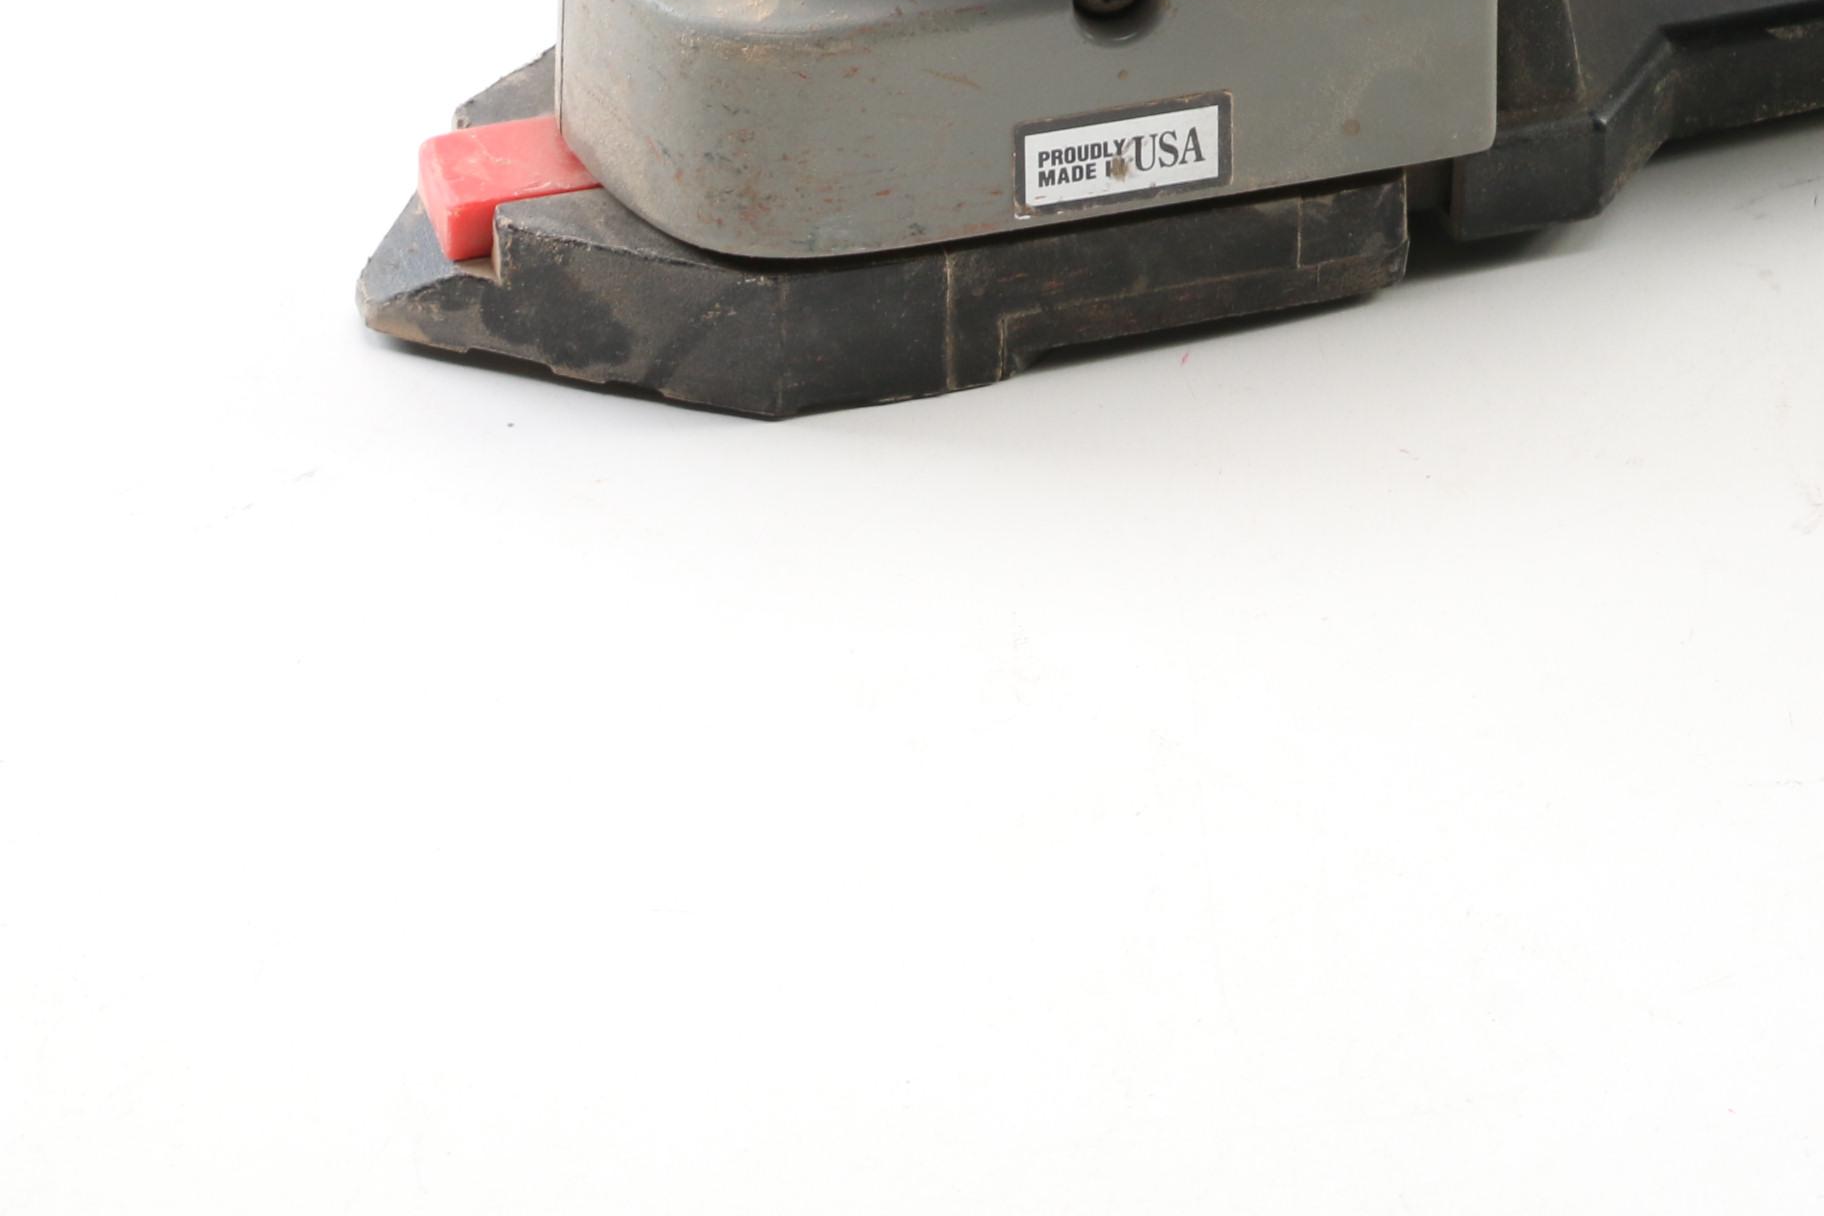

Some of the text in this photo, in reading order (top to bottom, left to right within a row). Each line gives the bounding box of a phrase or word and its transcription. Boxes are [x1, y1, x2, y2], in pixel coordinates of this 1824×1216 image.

[1038, 126, 1206, 172] PROUDLY USA
[1038, 163, 1097, 188] MADE
